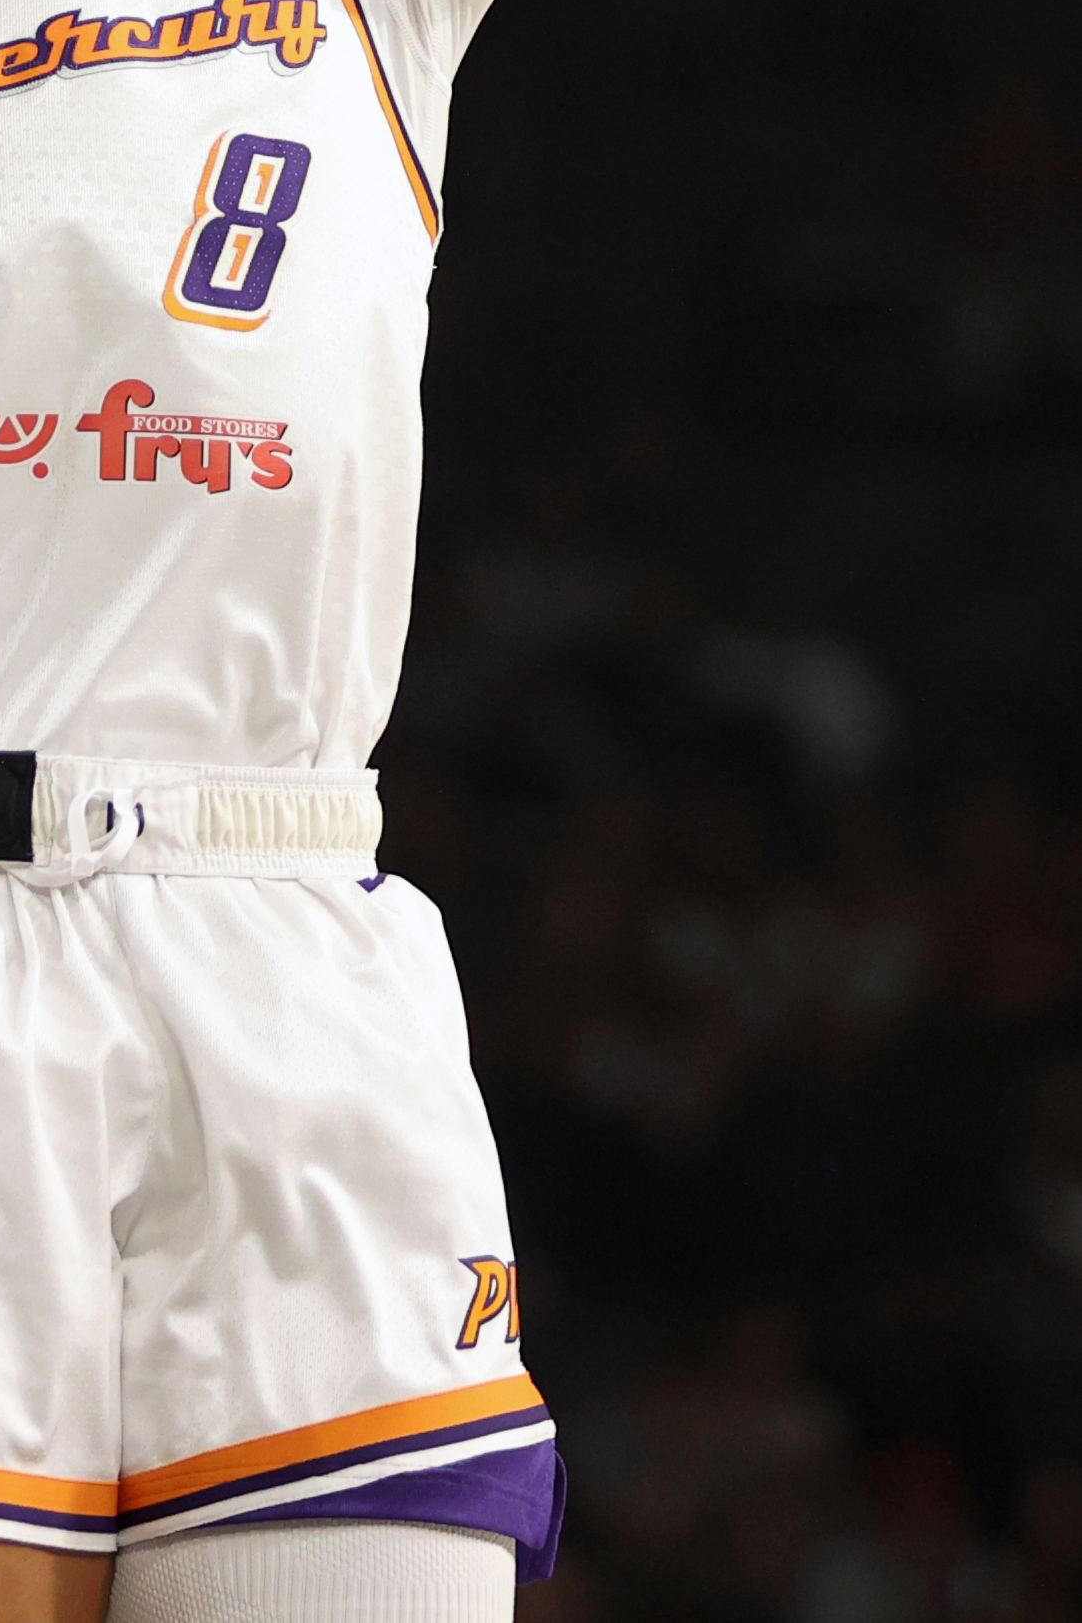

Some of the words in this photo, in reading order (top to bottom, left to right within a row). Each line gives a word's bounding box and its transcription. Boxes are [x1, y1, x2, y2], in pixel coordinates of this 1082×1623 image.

[162, 129, 312, 333] 8
[75, 379, 293, 494] fry's
[131, 416, 193, 432] FOOD
[200, 418, 279, 438] STORES
